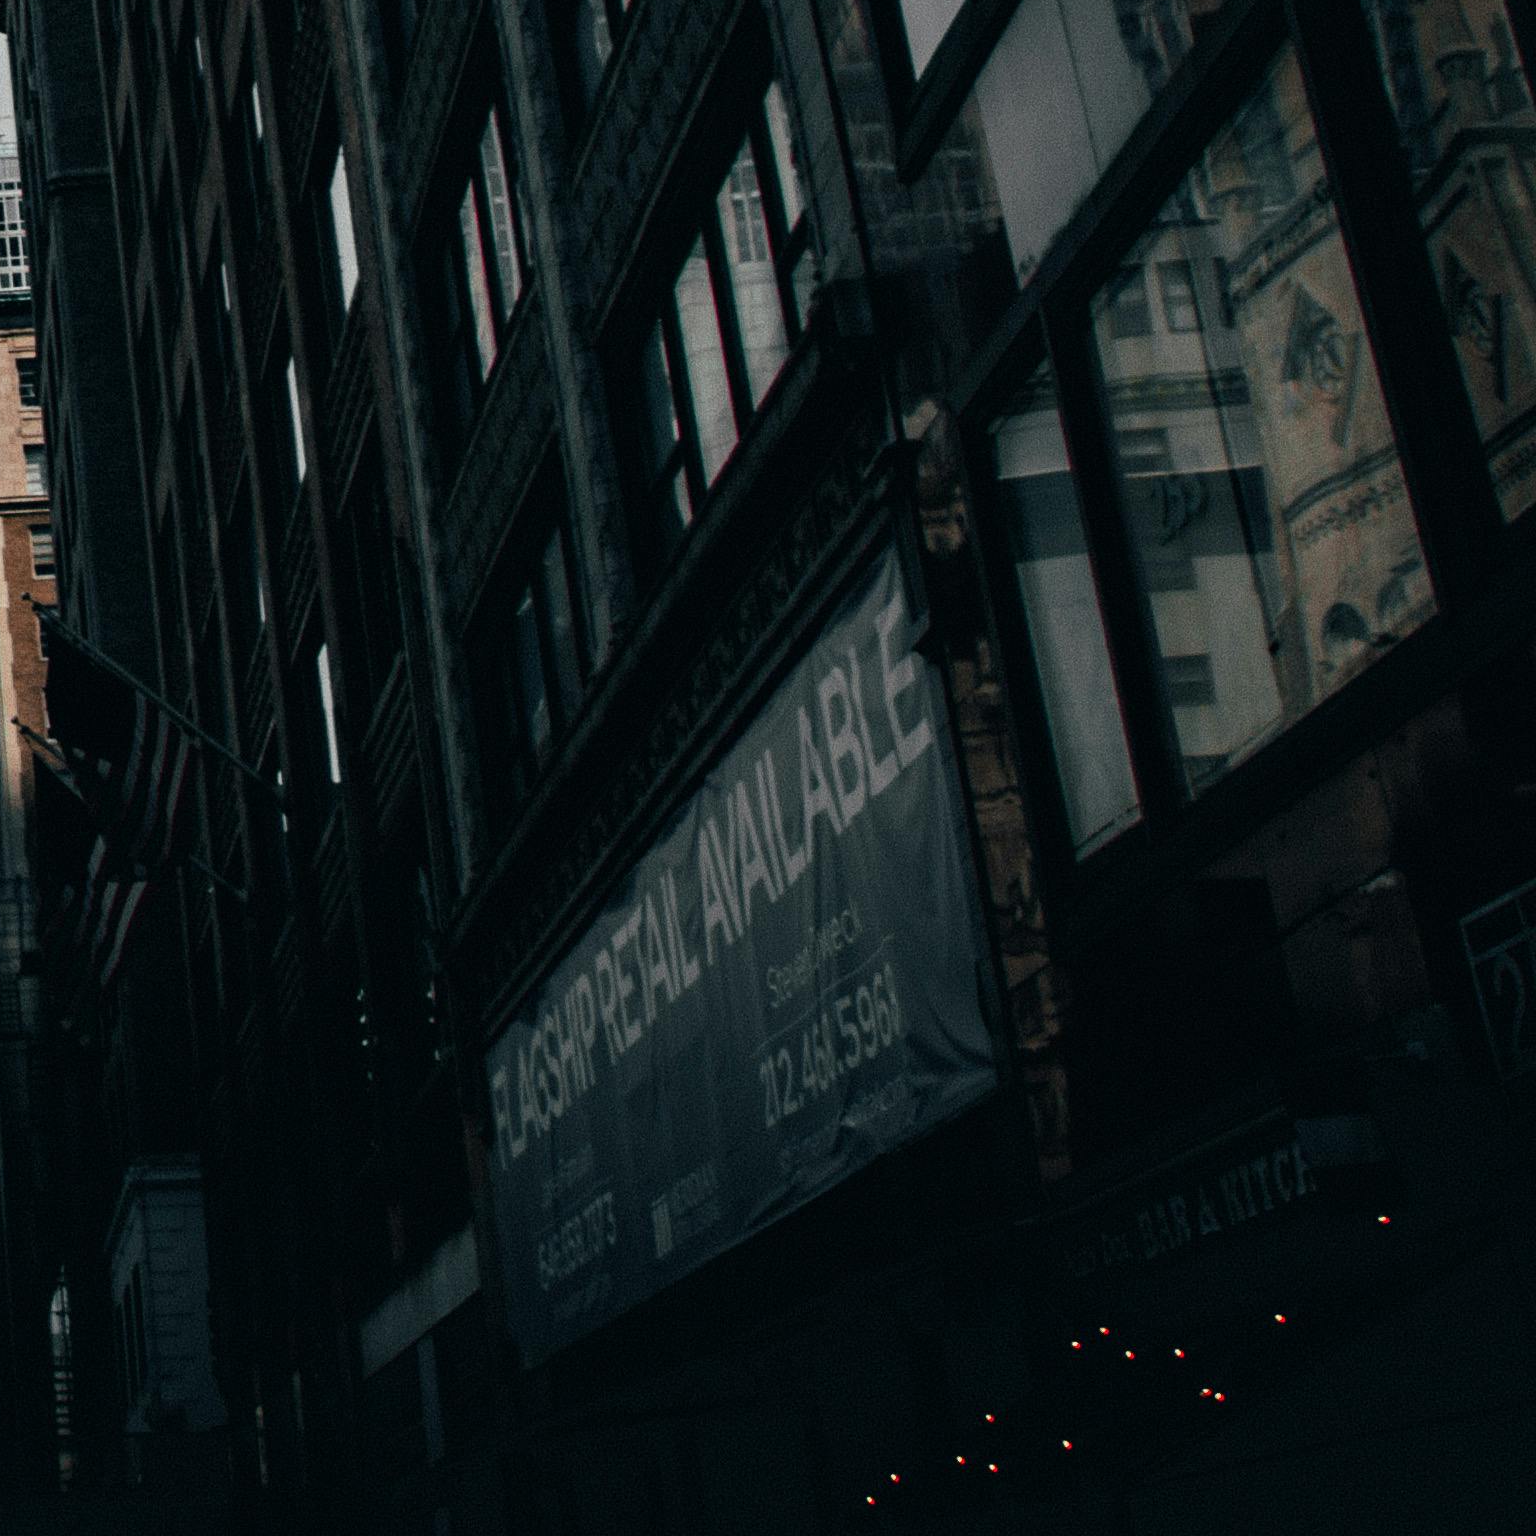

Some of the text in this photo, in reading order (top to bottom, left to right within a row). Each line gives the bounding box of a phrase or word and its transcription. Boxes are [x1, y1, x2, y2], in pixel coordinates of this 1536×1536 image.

[491, 964, 597, 1169] FLAGSHIP
[595, 871, 701, 1065] RETAIL
[694, 593, 932, 966] AVAILABLE
[1219, 1141, 1319, 1227] KITCH
